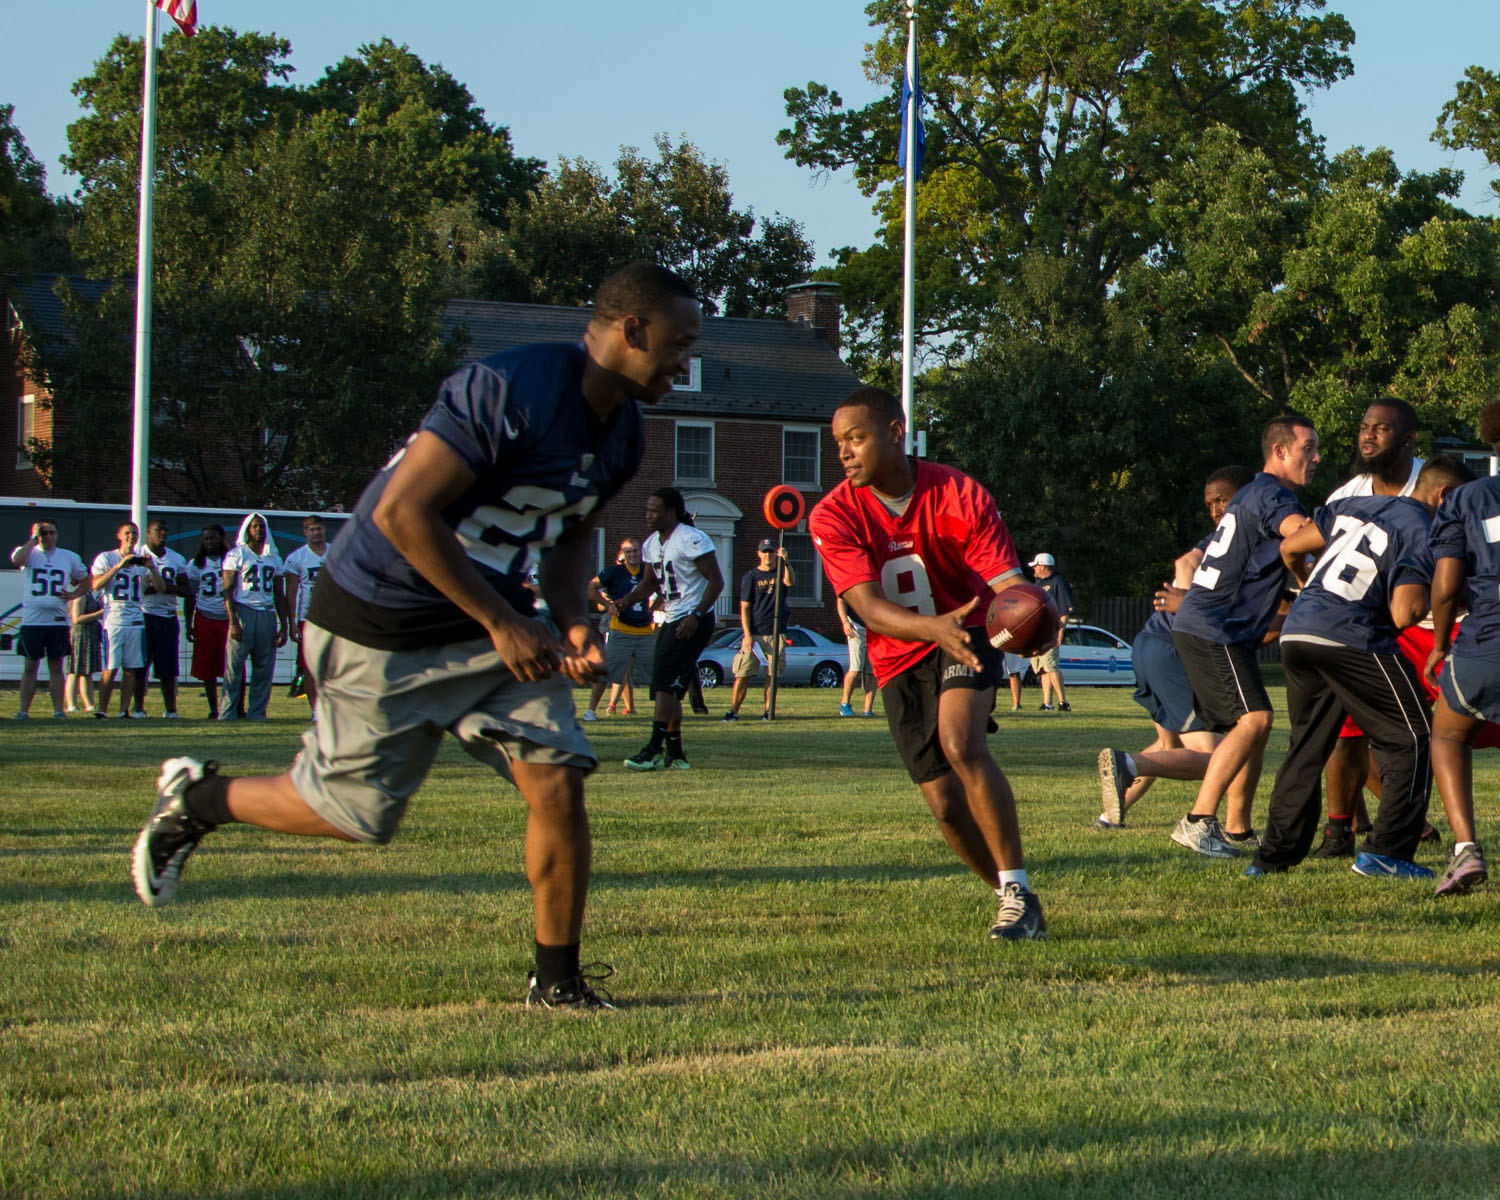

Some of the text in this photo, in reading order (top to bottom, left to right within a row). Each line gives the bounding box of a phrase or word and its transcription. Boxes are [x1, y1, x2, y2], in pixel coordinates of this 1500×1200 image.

[1304, 515, 1388, 601] 76
[32, 568, 66, 596] 52
[113, 573, 140, 602] 21
[243, 564, 275, 592] 48
